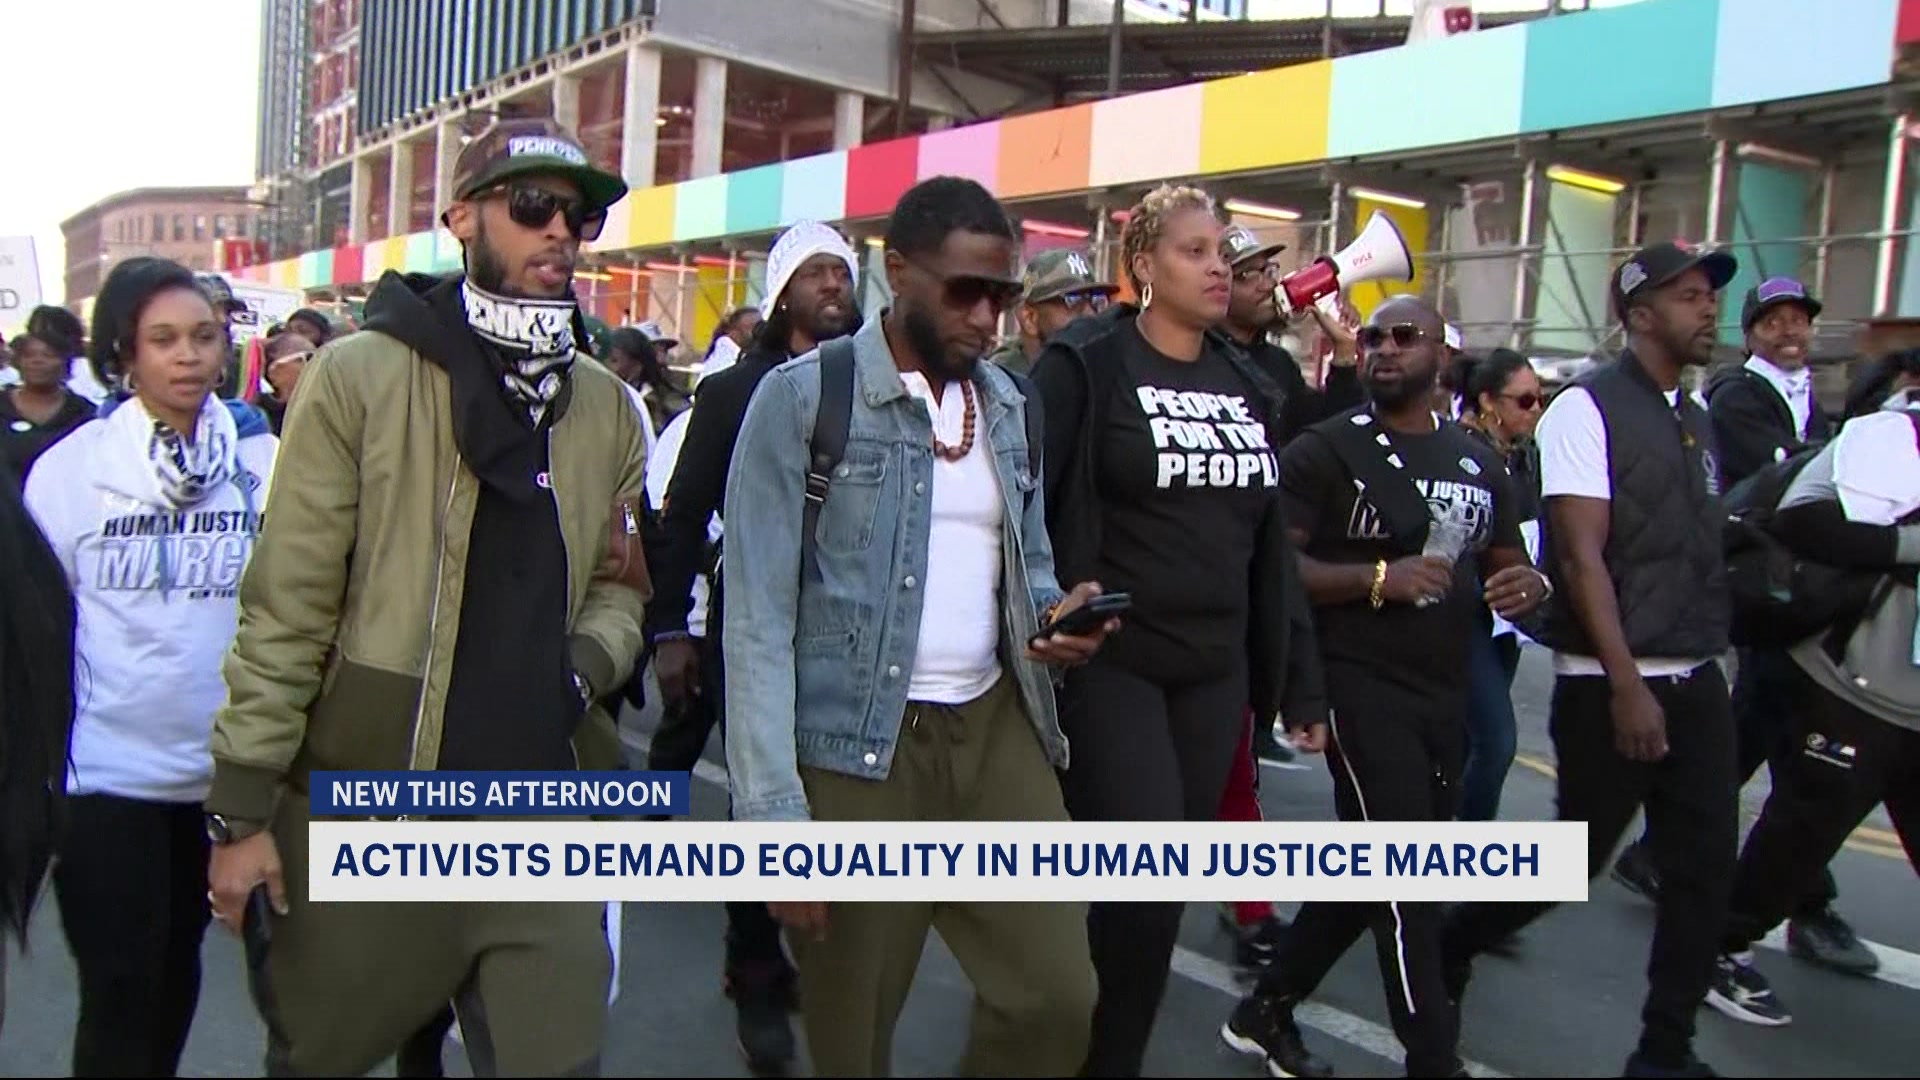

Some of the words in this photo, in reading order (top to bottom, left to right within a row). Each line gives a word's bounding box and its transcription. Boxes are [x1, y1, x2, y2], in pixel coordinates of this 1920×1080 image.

[1136, 385, 1256, 424] PEOPLE
[1149, 416, 1224, 450] FOR
[103, 512, 186, 537] HUMAN
[97, 533, 250, 590] MARC
